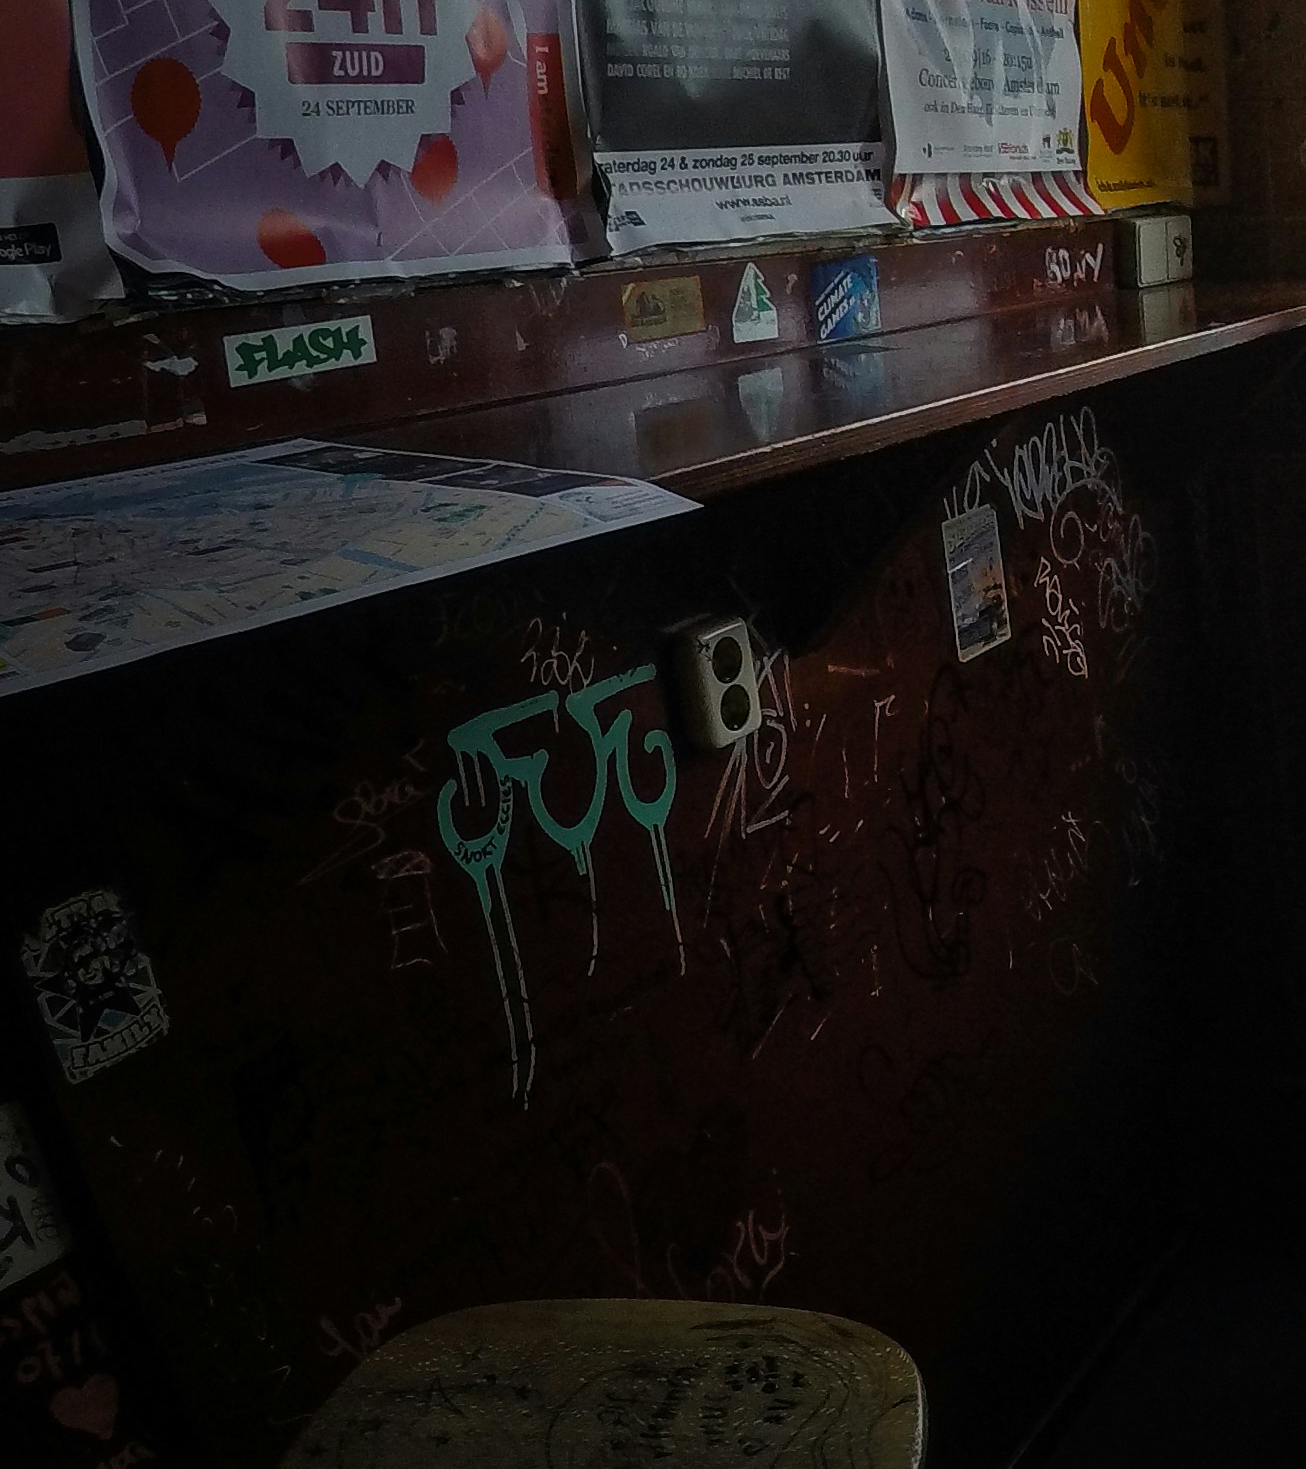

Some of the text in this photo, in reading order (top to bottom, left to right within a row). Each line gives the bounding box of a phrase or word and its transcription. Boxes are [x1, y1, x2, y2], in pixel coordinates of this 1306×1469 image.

[332, 50, 385, 78] ZUID
[301, 99, 416, 119] 24 SEPTEMBER
[660, 157, 675, 171] 24
[692, 154, 738, 172] zondag
[757, 151, 820, 167] september
[611, 169, 882, 196] ADSSCHOUWBURG AMSTERDAM
[24, 242, 52, 258] Play
[816, 273, 854, 323] CLIMATE
[819, 299, 852, 341] GAMES
[233, 325, 369, 380] FLASH
